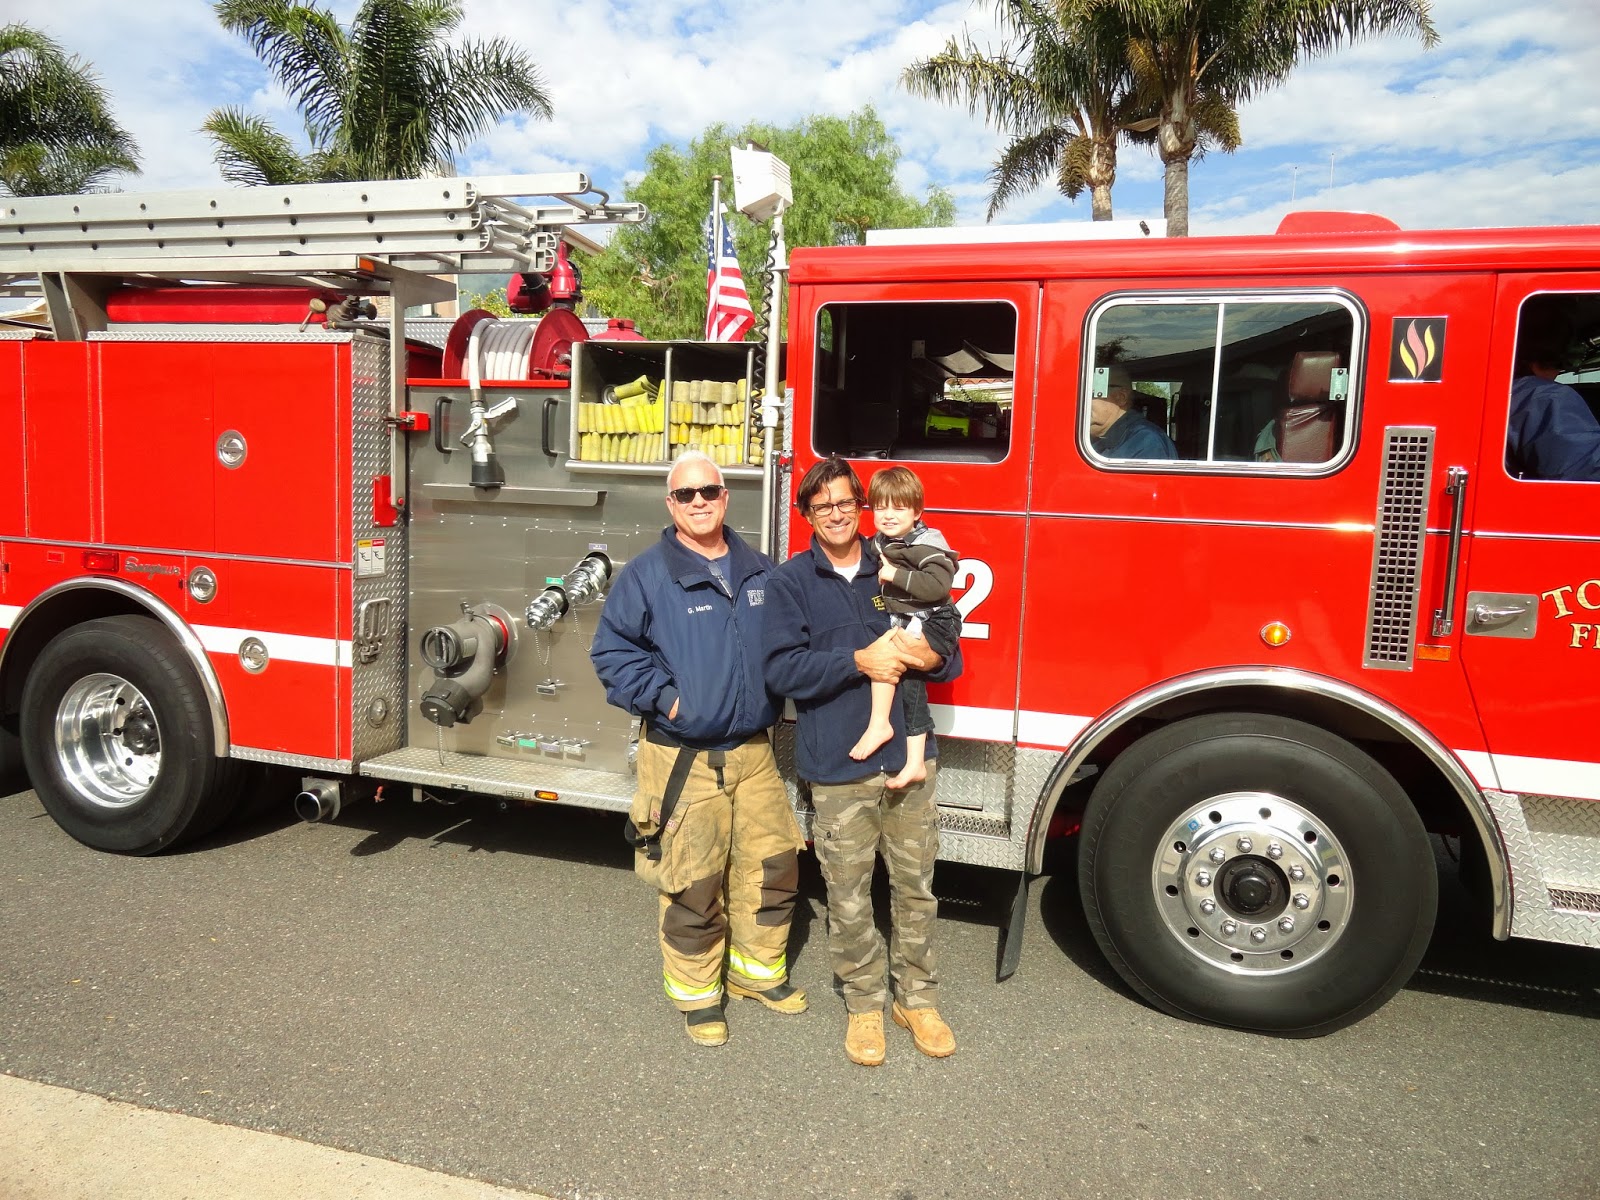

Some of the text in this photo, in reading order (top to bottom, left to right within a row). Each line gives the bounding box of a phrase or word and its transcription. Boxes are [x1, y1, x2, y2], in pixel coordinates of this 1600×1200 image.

[687, 604, 713, 615] G. Martin
[951, 557, 995, 640] 2
